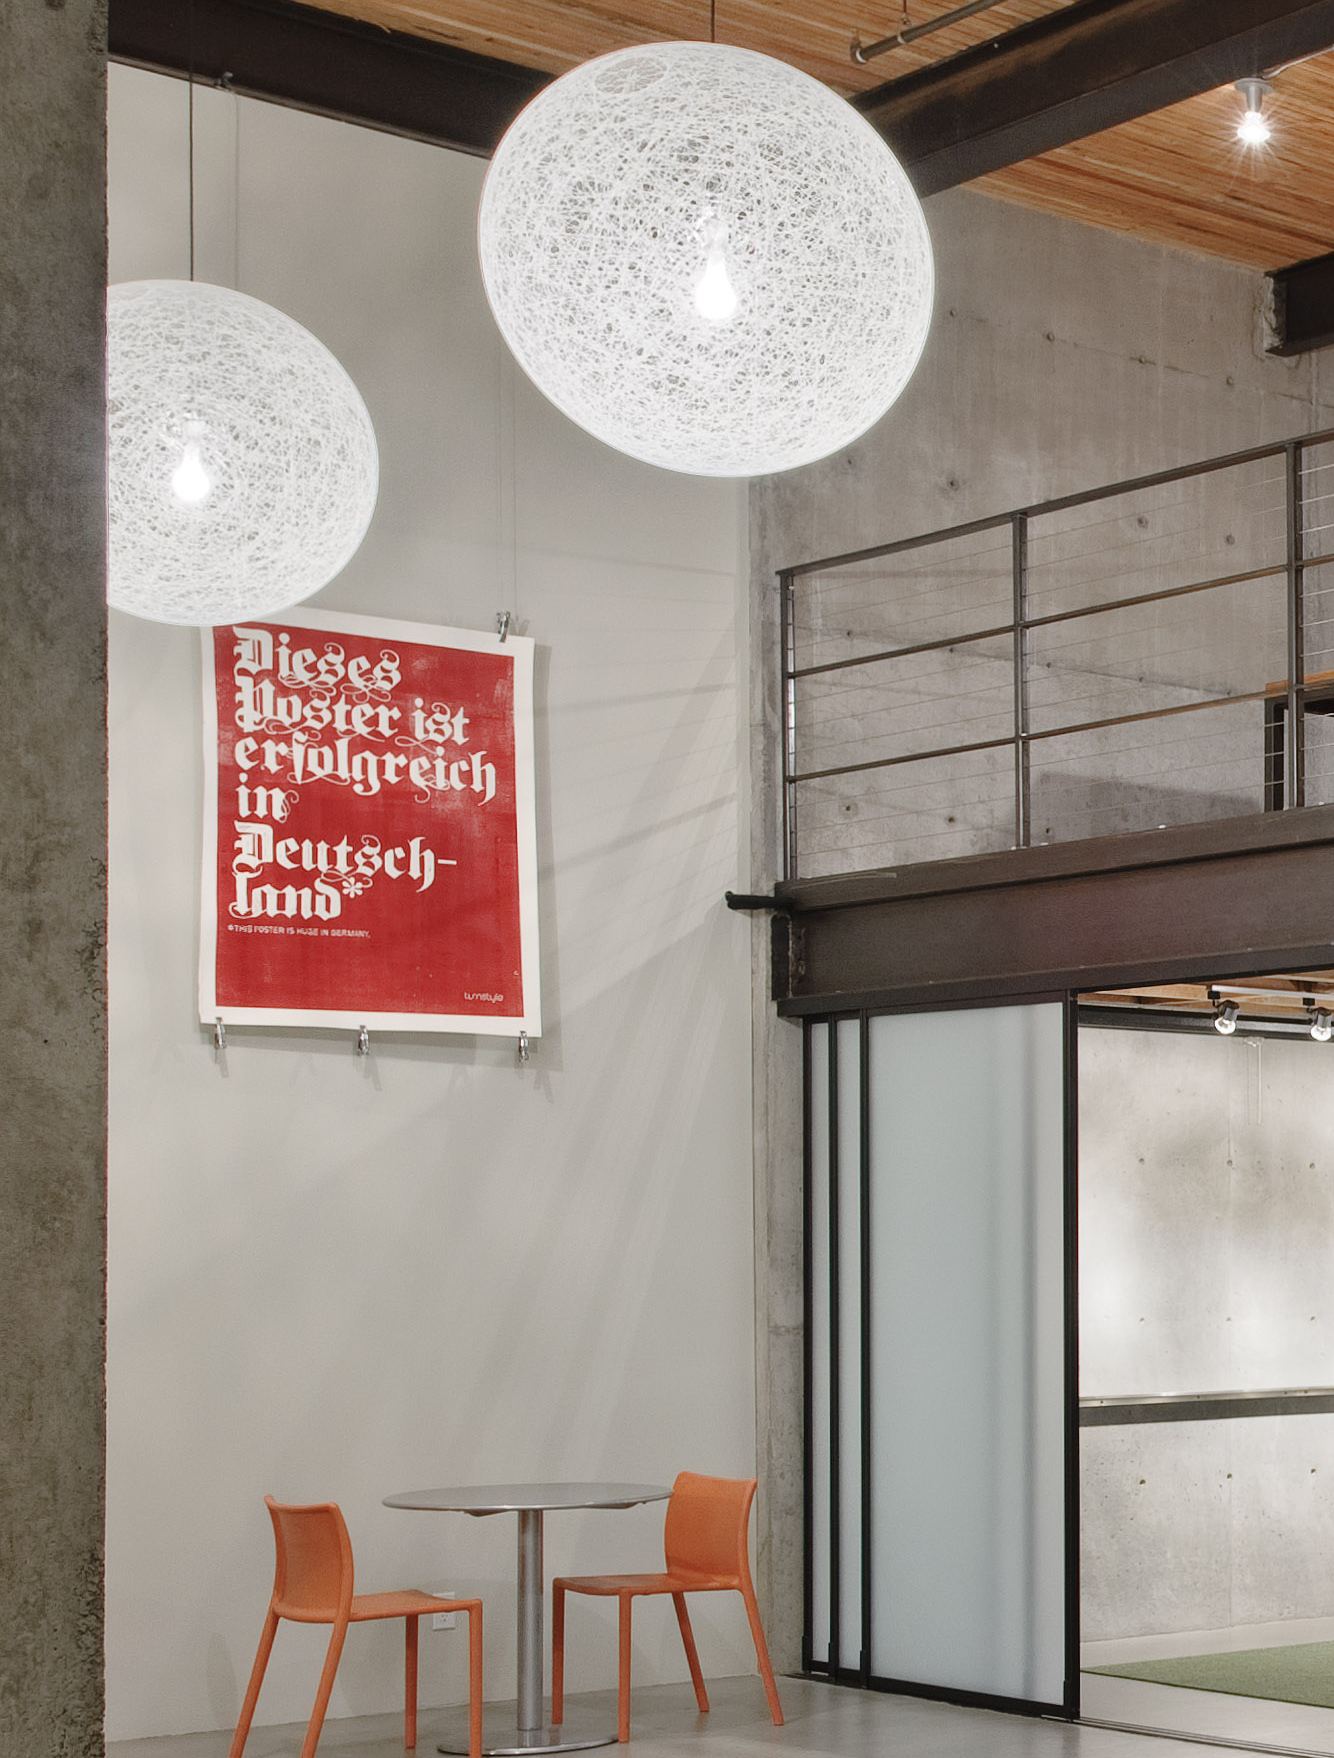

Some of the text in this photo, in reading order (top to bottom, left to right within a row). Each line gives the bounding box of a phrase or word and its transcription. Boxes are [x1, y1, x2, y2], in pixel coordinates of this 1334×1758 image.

[233, 626, 401, 700] Dieses
[234, 674, 470, 747] Poster ist
[234, 731, 497, 806] erfolgreich
[235, 773, 299, 823] in
[233, 820, 458, 893] Deutsch-
